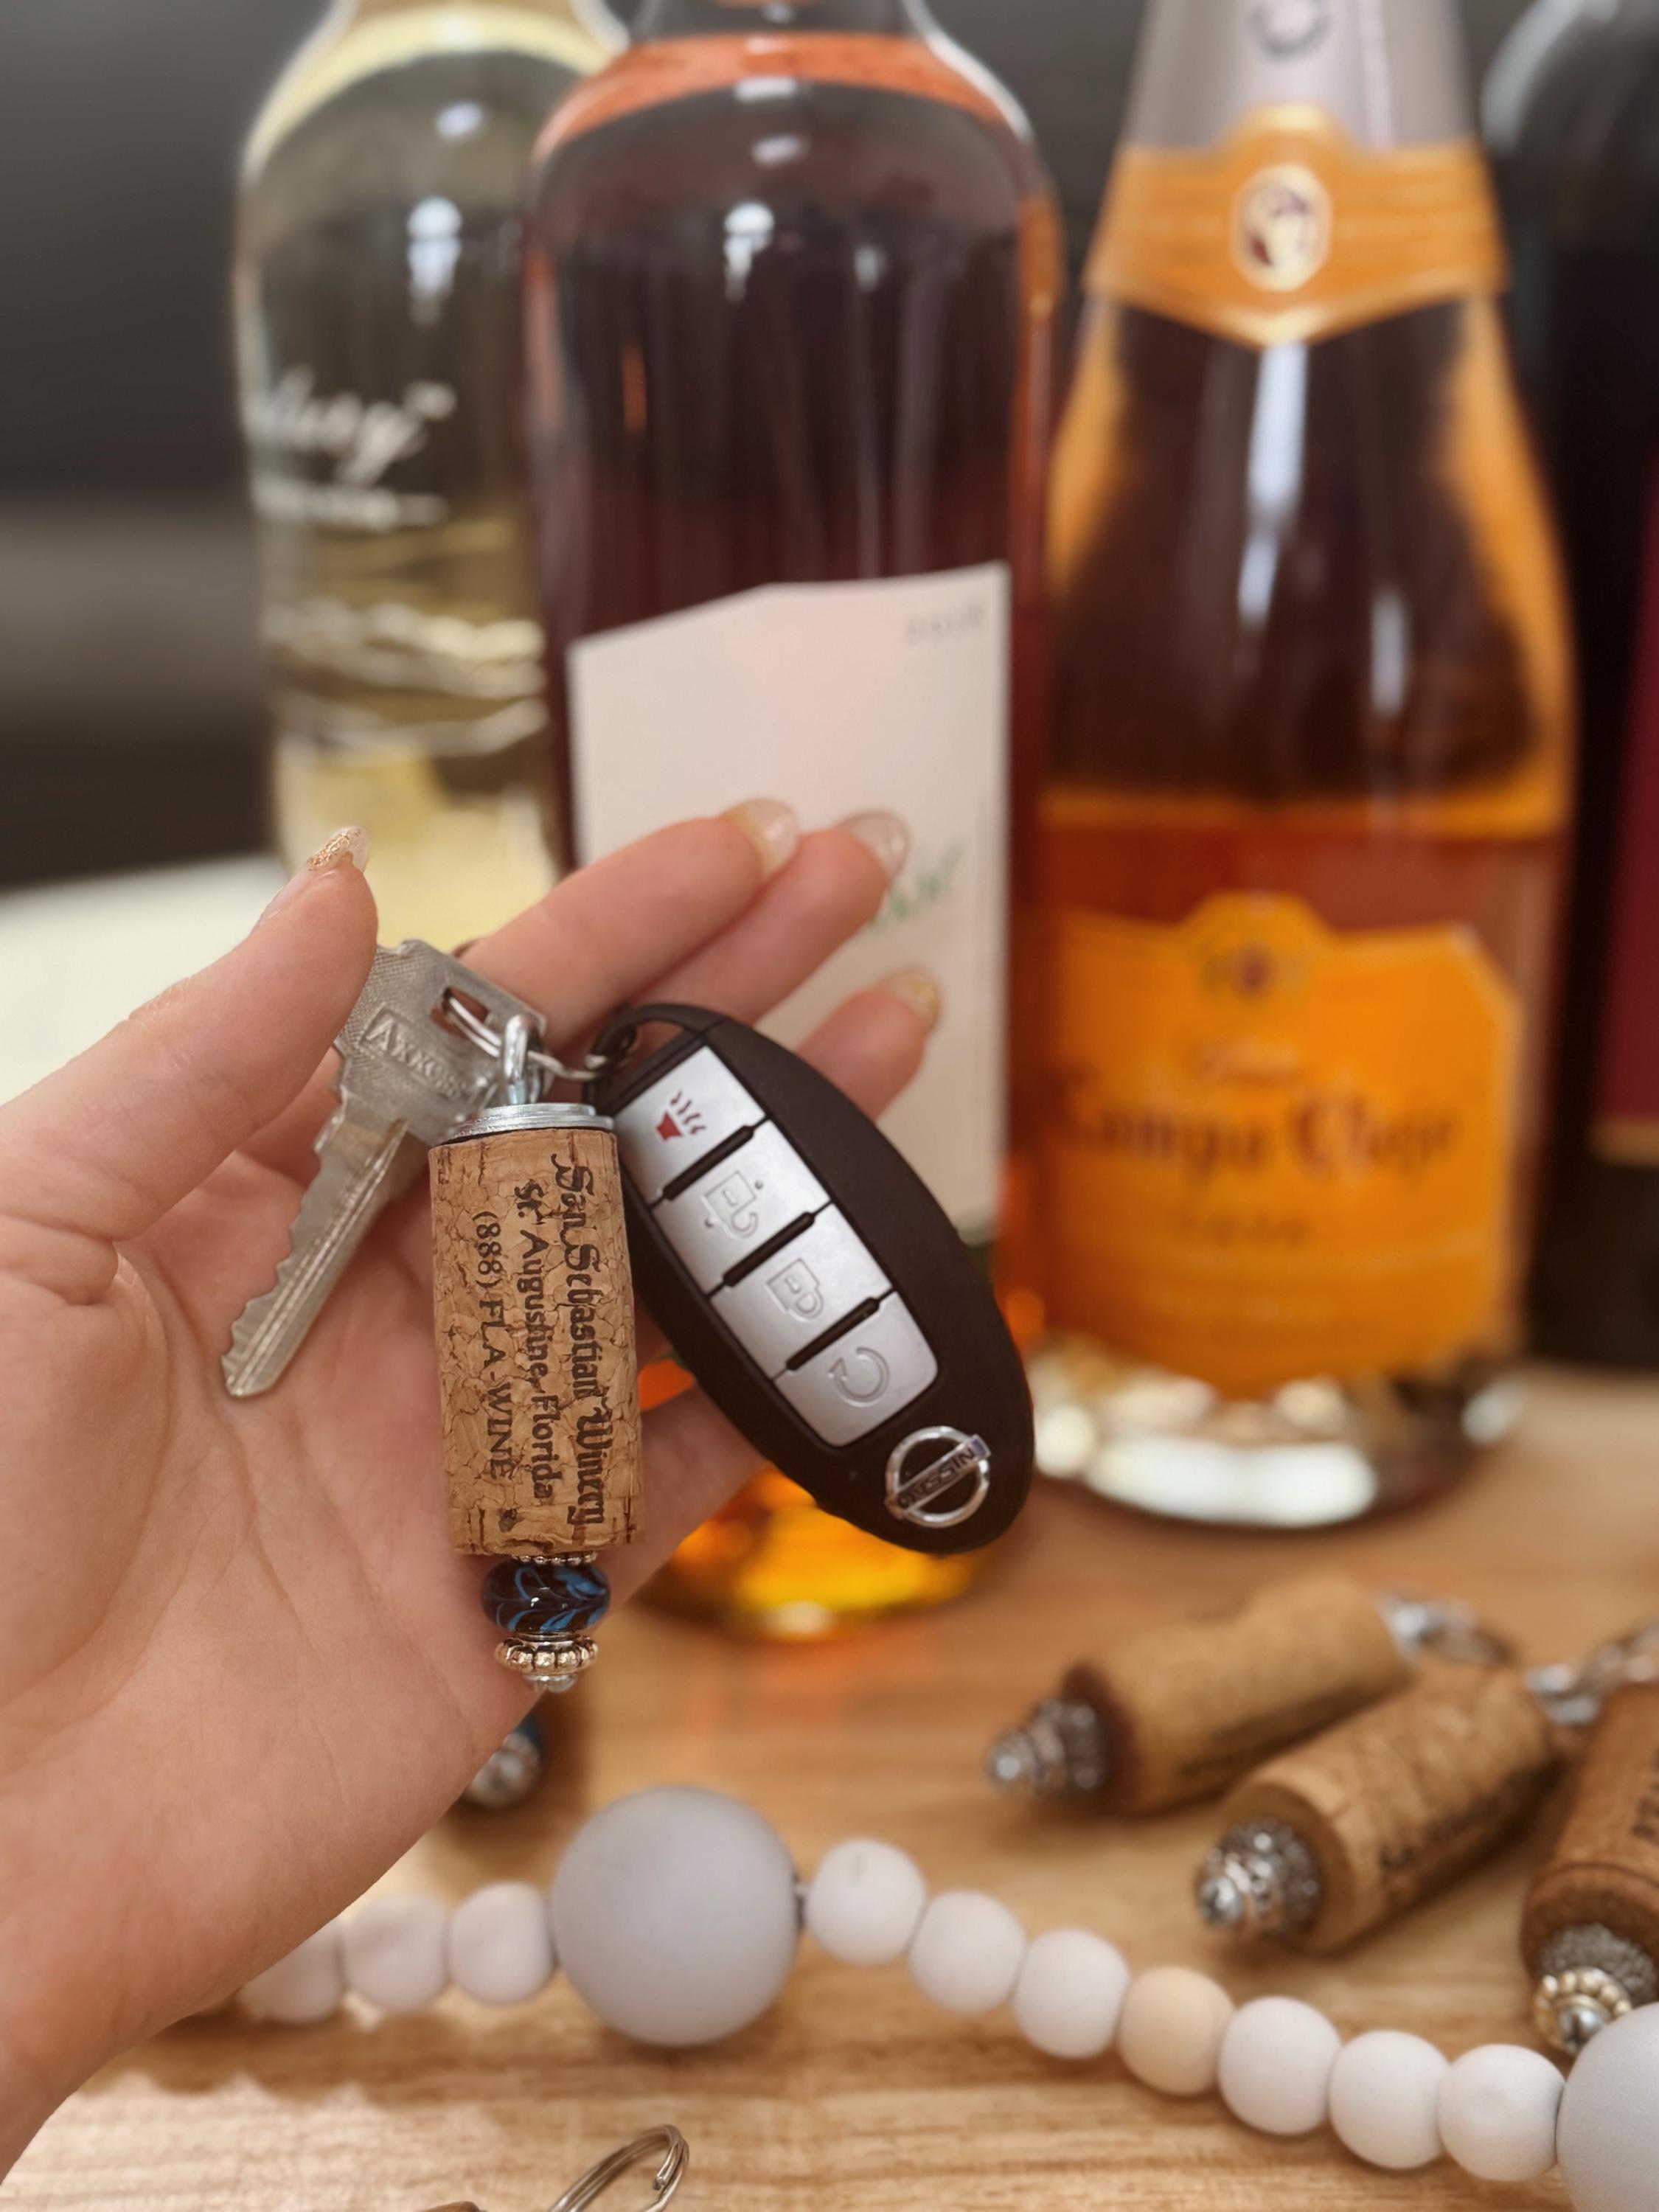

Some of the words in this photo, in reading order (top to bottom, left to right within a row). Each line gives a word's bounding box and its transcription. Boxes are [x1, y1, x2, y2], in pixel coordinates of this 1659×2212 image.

[472, 1211, 502, 1288] (888)
[551, 1152, 594, 1228] San
[514, 1180, 546, 1218] St.
[531, 1394, 563, 1500] Florida
[559, 1227, 605, 1399] Sebastian
[479, 1298, 516, 1481] FLA-WINE
[566, 1396, 613, 1526] Winery
